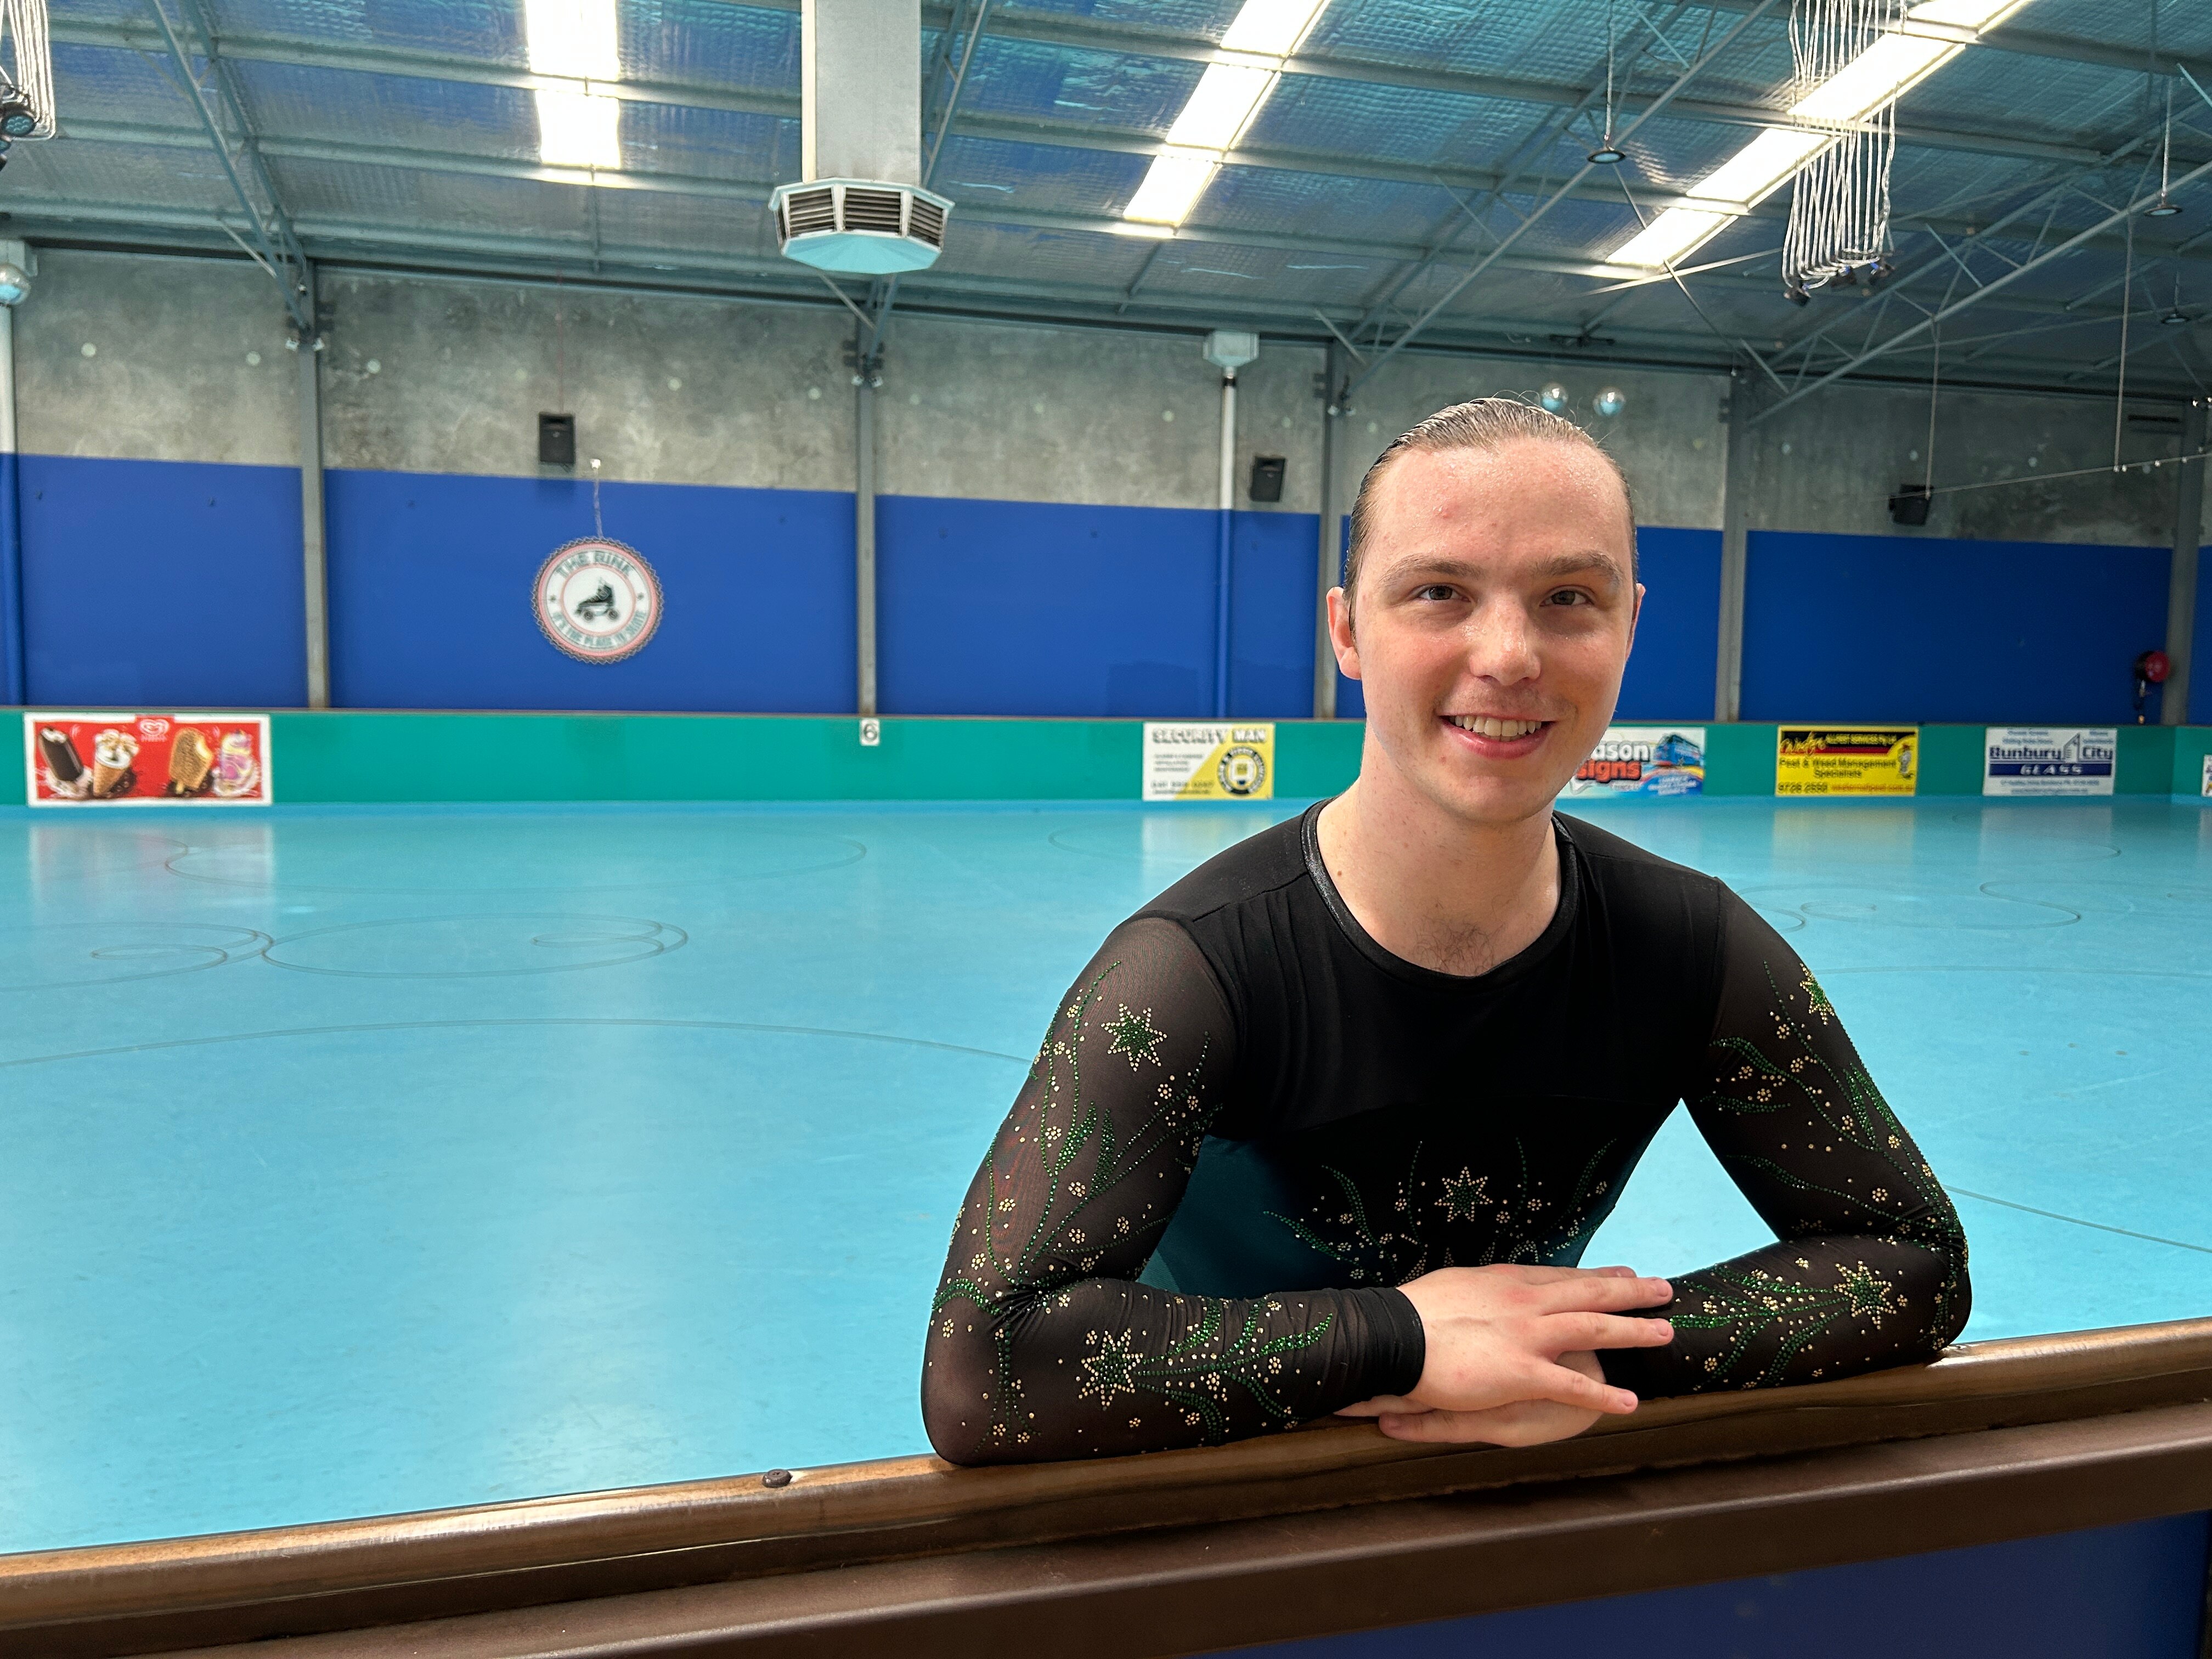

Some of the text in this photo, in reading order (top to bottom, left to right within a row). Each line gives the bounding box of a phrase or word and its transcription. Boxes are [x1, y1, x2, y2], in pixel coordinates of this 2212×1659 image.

[555, 552, 588, 578] THE
[864, 723, 878, 742] 6
[1152, 728, 1266, 743] SECURITY MAN
[1590, 741, 1650, 761] ason
[1989, 746, 2113, 760] Bunbury City
[1779, 758, 1800, 768] Pest
[1802, 758, 1809, 768] &
[1838, 759, 1896, 770] Management
[2020, 764, 2083, 775] GLASS
[1814, 770, 1861, 779] Specialists
